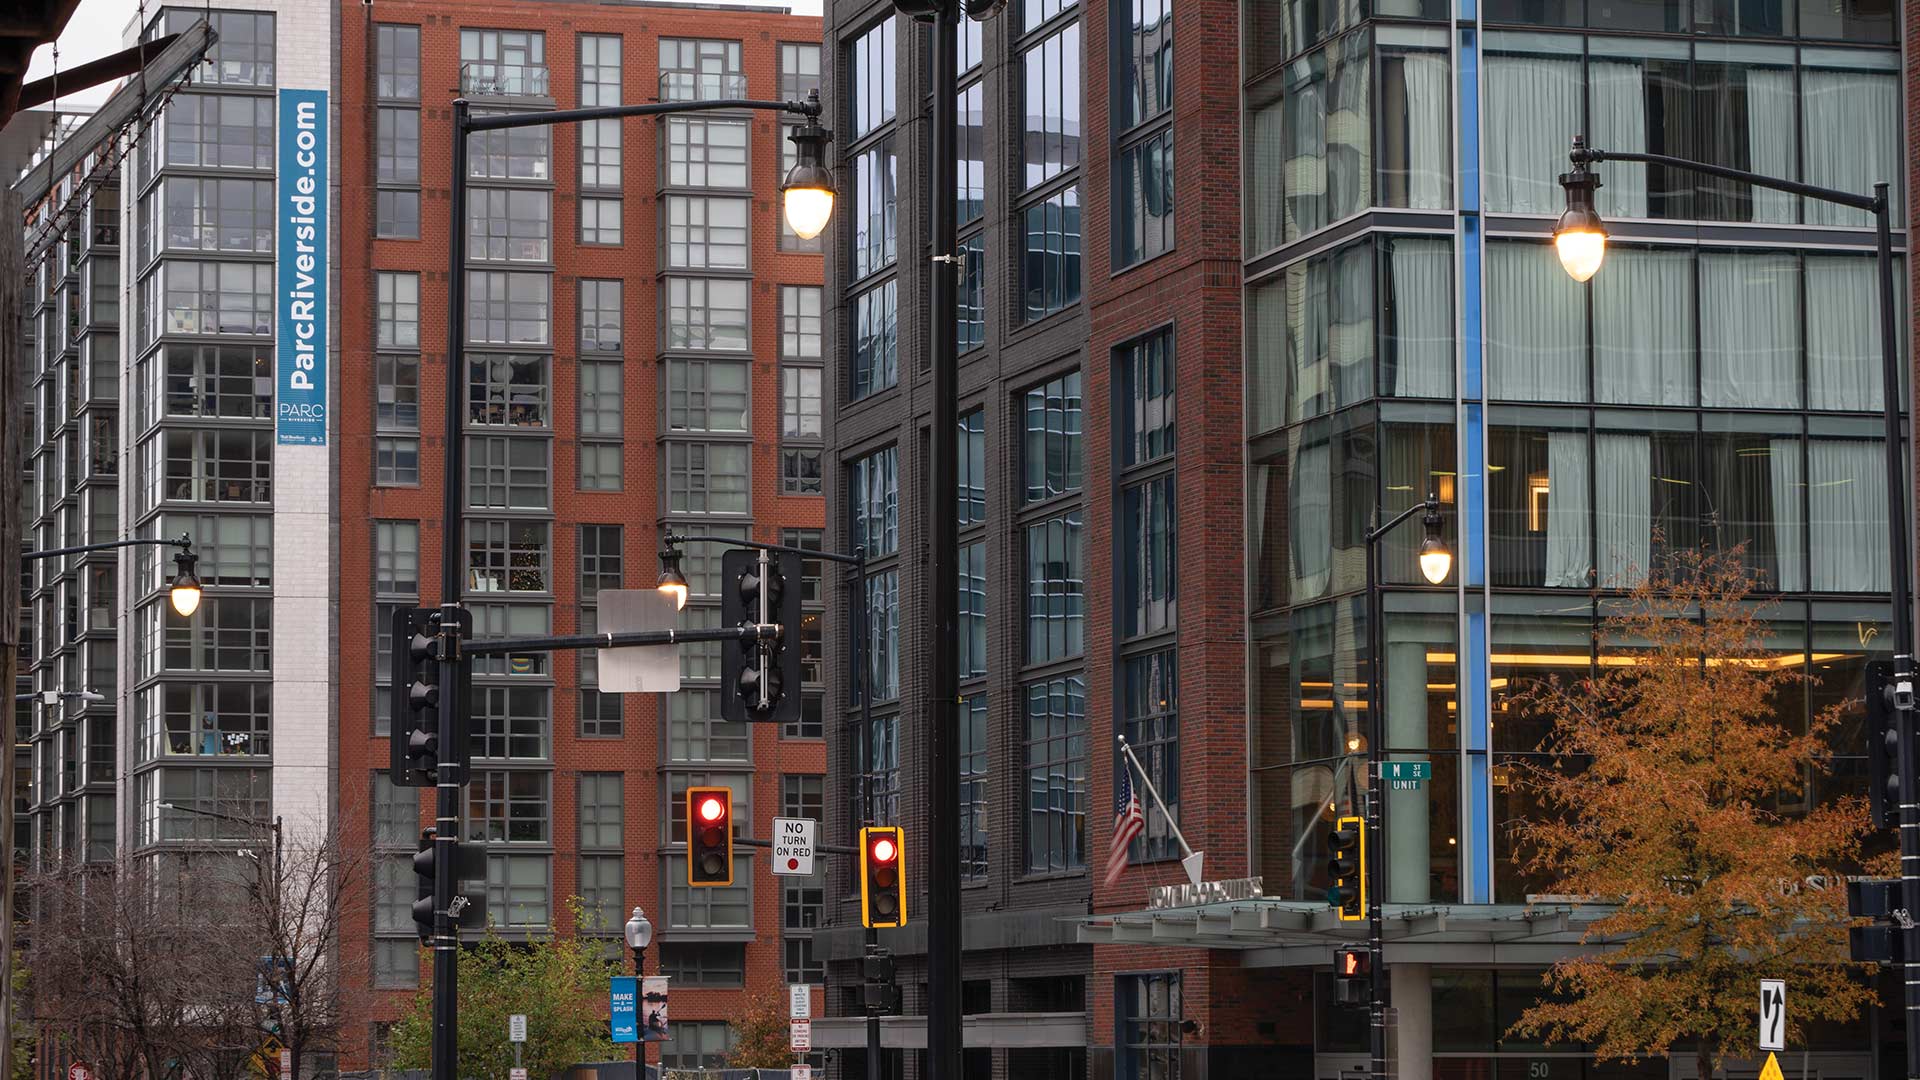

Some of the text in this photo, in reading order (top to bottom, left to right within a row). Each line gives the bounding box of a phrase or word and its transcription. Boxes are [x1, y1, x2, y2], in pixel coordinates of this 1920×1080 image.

[290, 102, 316, 390] ParcRiverside.com
[280, 403, 324, 417] PARC
[1393, 764, 1400, 777] M
[1393, 780, 1417, 790] UNIT
[785, 823, 804, 834] NO
[782, 836, 807, 845] TURN
[776, 847, 811, 857] ON RED
[613, 993, 633, 1001] MAKE
[1530, 1062, 1549, 1078] 50
